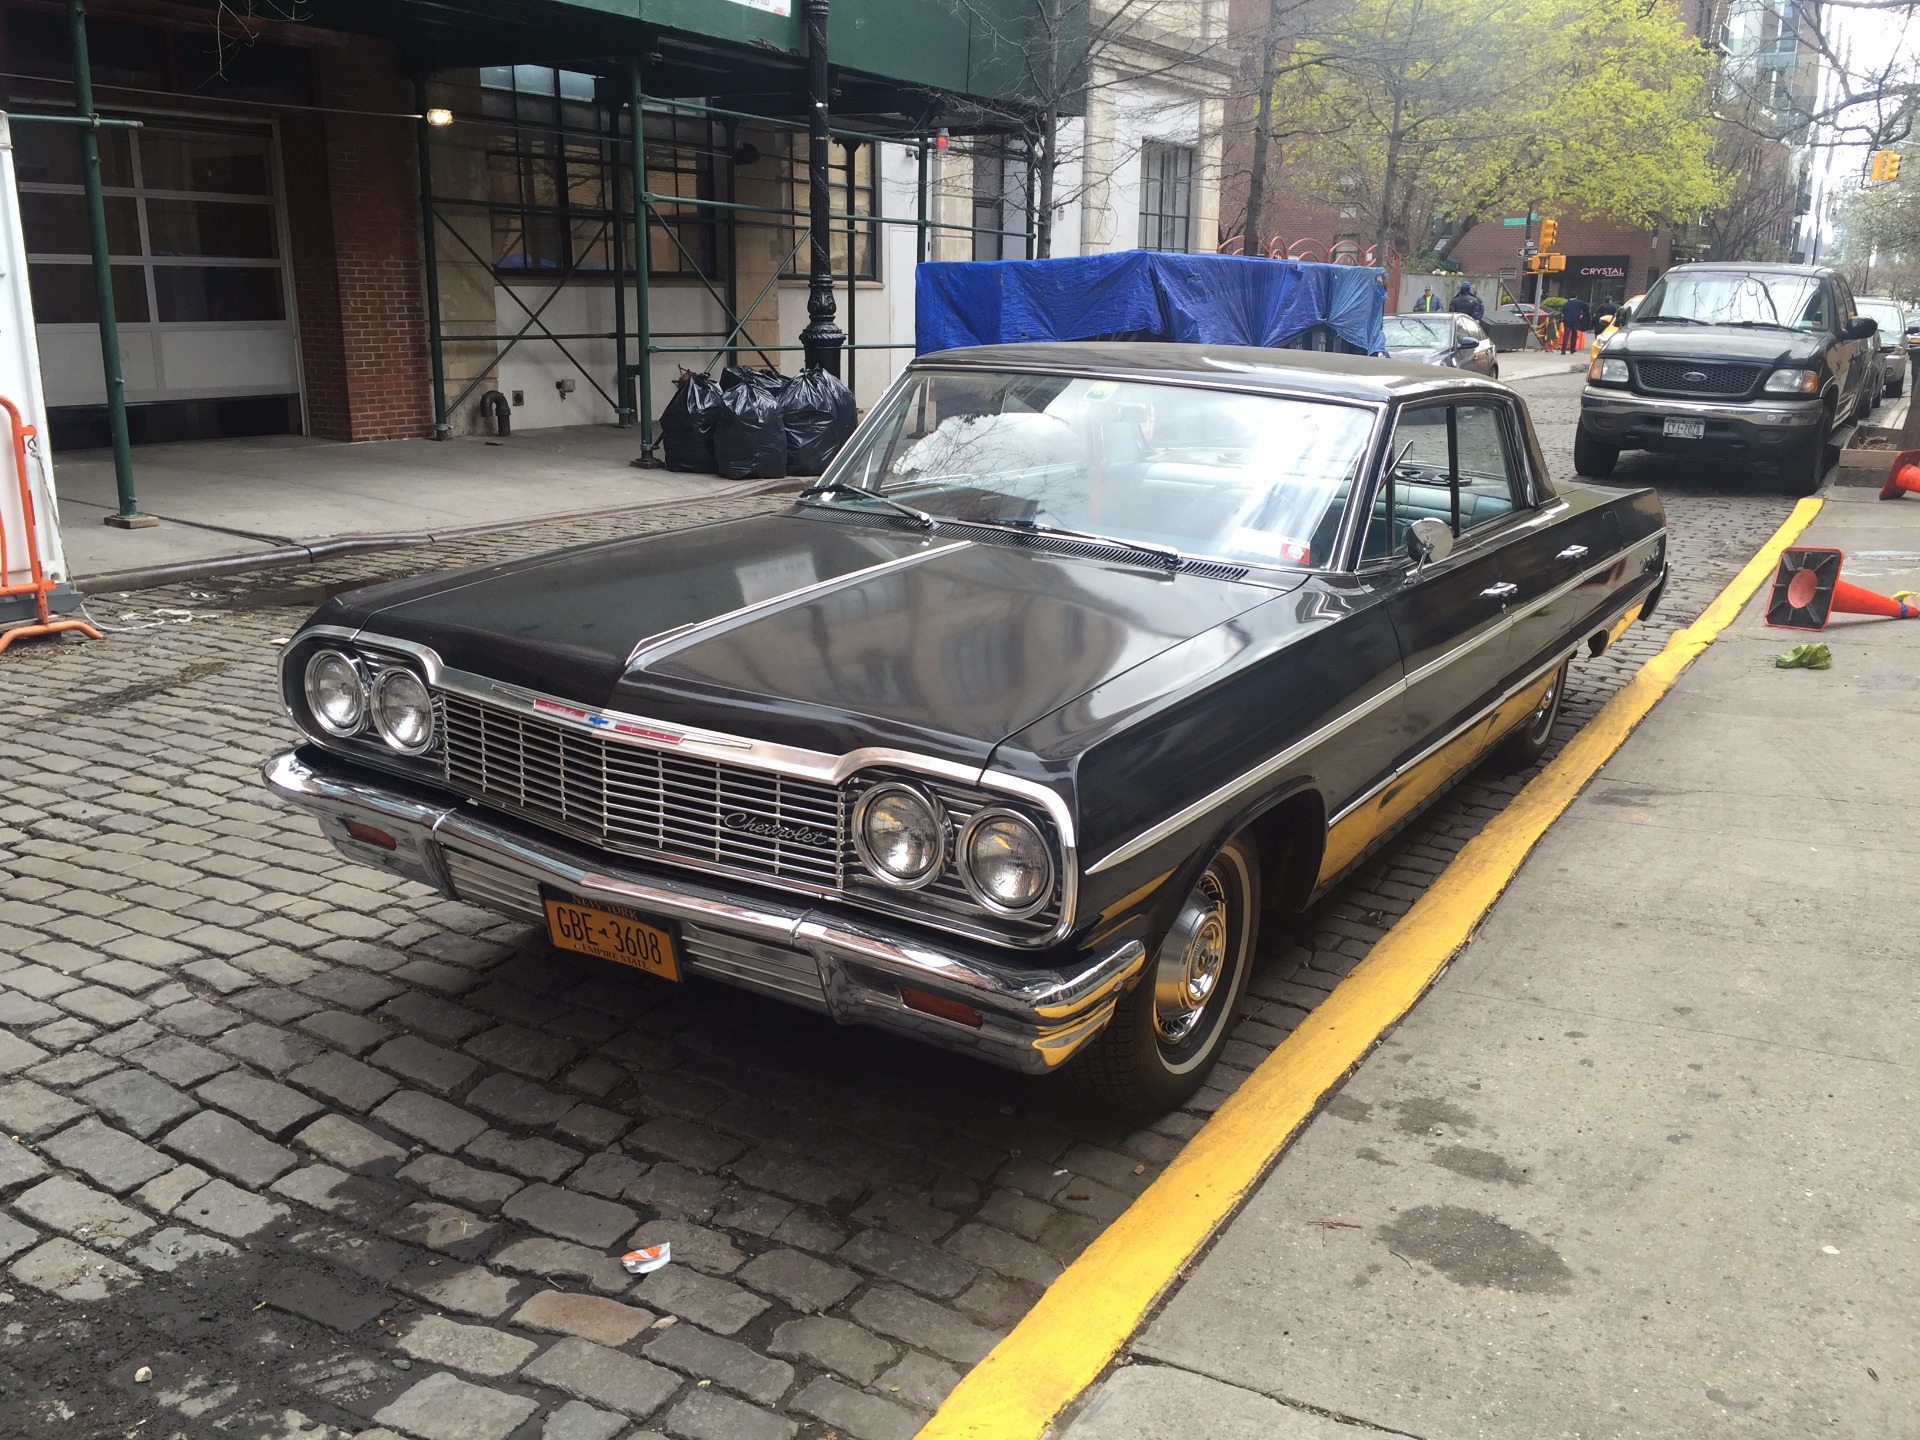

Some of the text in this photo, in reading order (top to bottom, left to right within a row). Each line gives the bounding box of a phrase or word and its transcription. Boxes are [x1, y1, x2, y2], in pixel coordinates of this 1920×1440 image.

[1580, 267, 1625, 275] CRYSTAL
[724, 812, 828, 845] Chevrolet
[572, 895, 638, 920] NEW YORK
[582, 943, 650, 969] EMPIRE STATE
